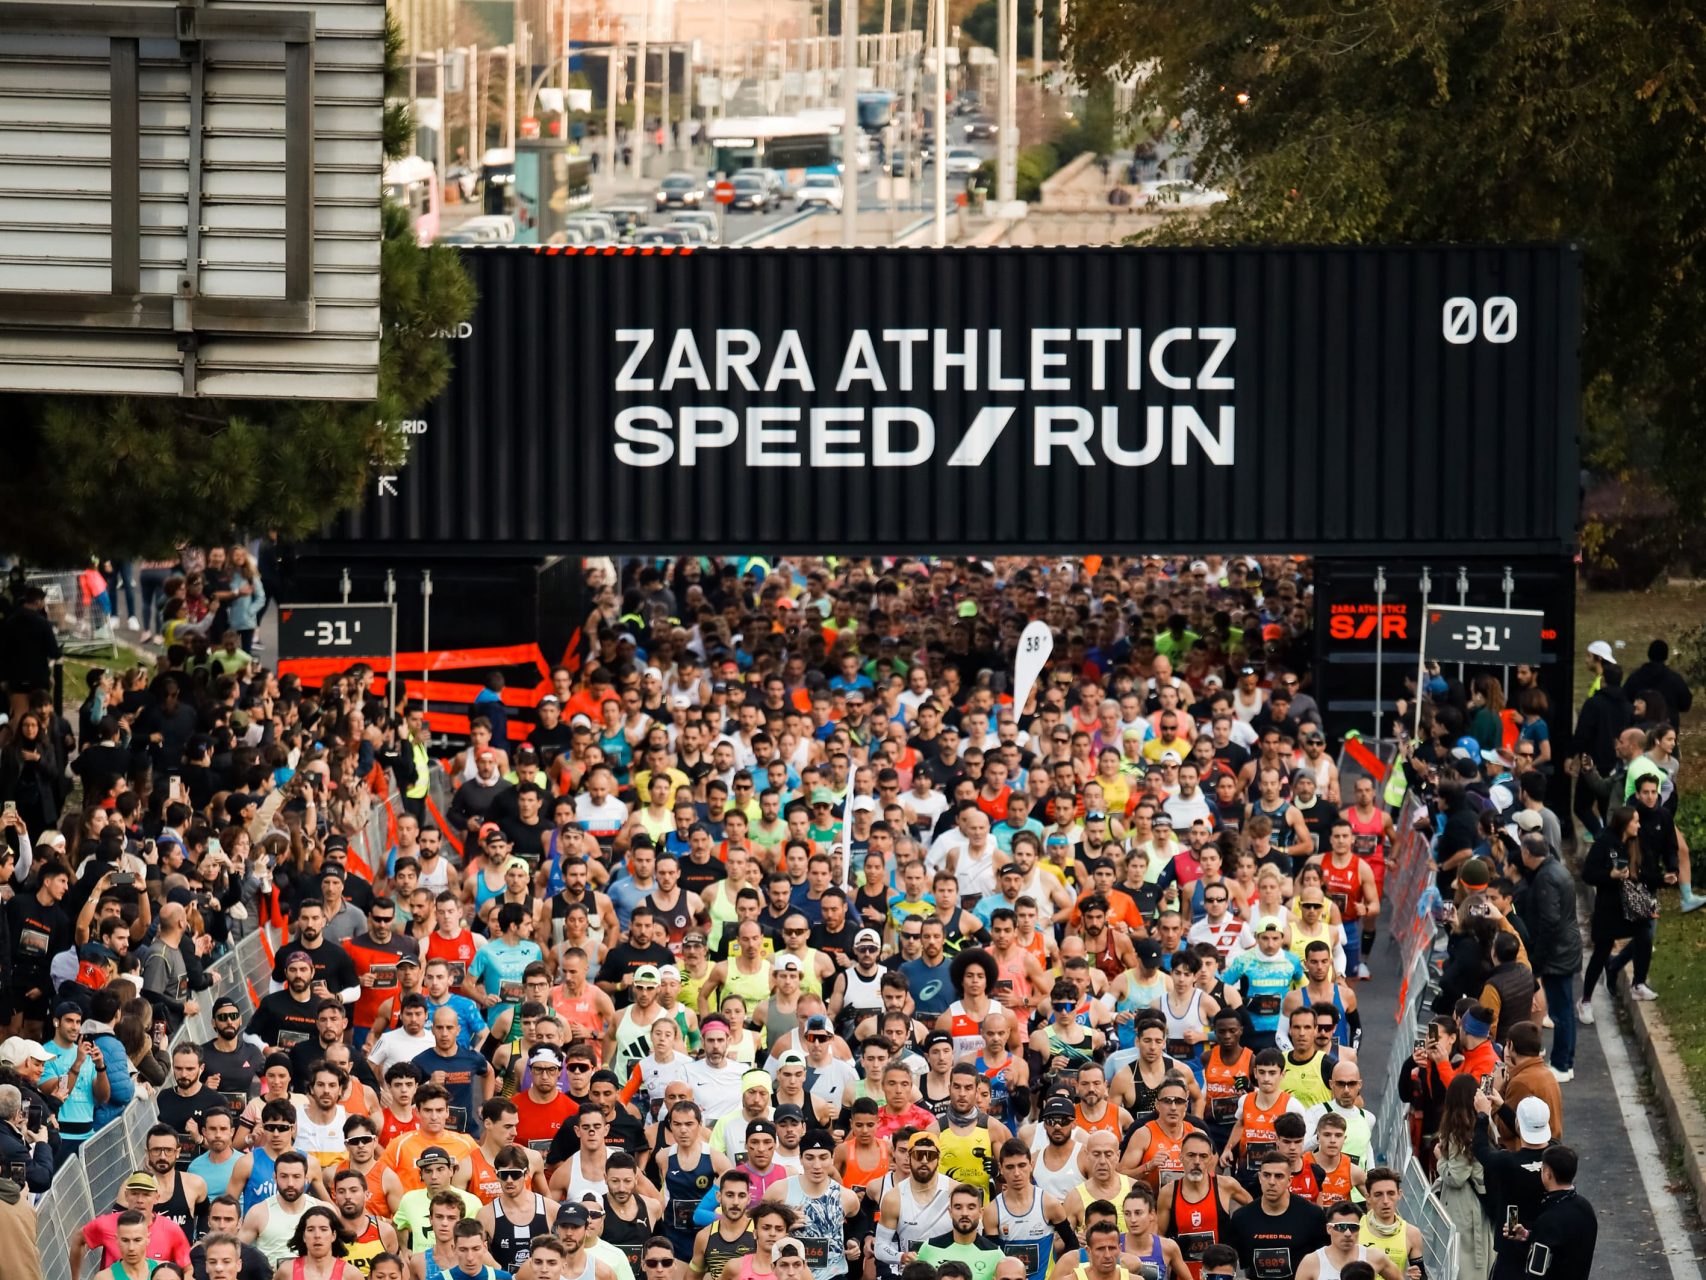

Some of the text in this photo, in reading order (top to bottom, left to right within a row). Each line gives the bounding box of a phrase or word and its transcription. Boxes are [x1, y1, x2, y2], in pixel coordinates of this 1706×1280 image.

[1442, 296, 1518, 345] 00
[615, 327, 1237, 392] ZARA ATHLETICZ
[613, 405, 936, 468] SPEED
[1033, 405, 1236, 468] RUN
[1357, 604, 1407, 614] ATHETICZ
[304, 620, 361, 646] -31'
[1452, 625, 1511, 651] -31'
[551, 1121, 561, 1129] EC
